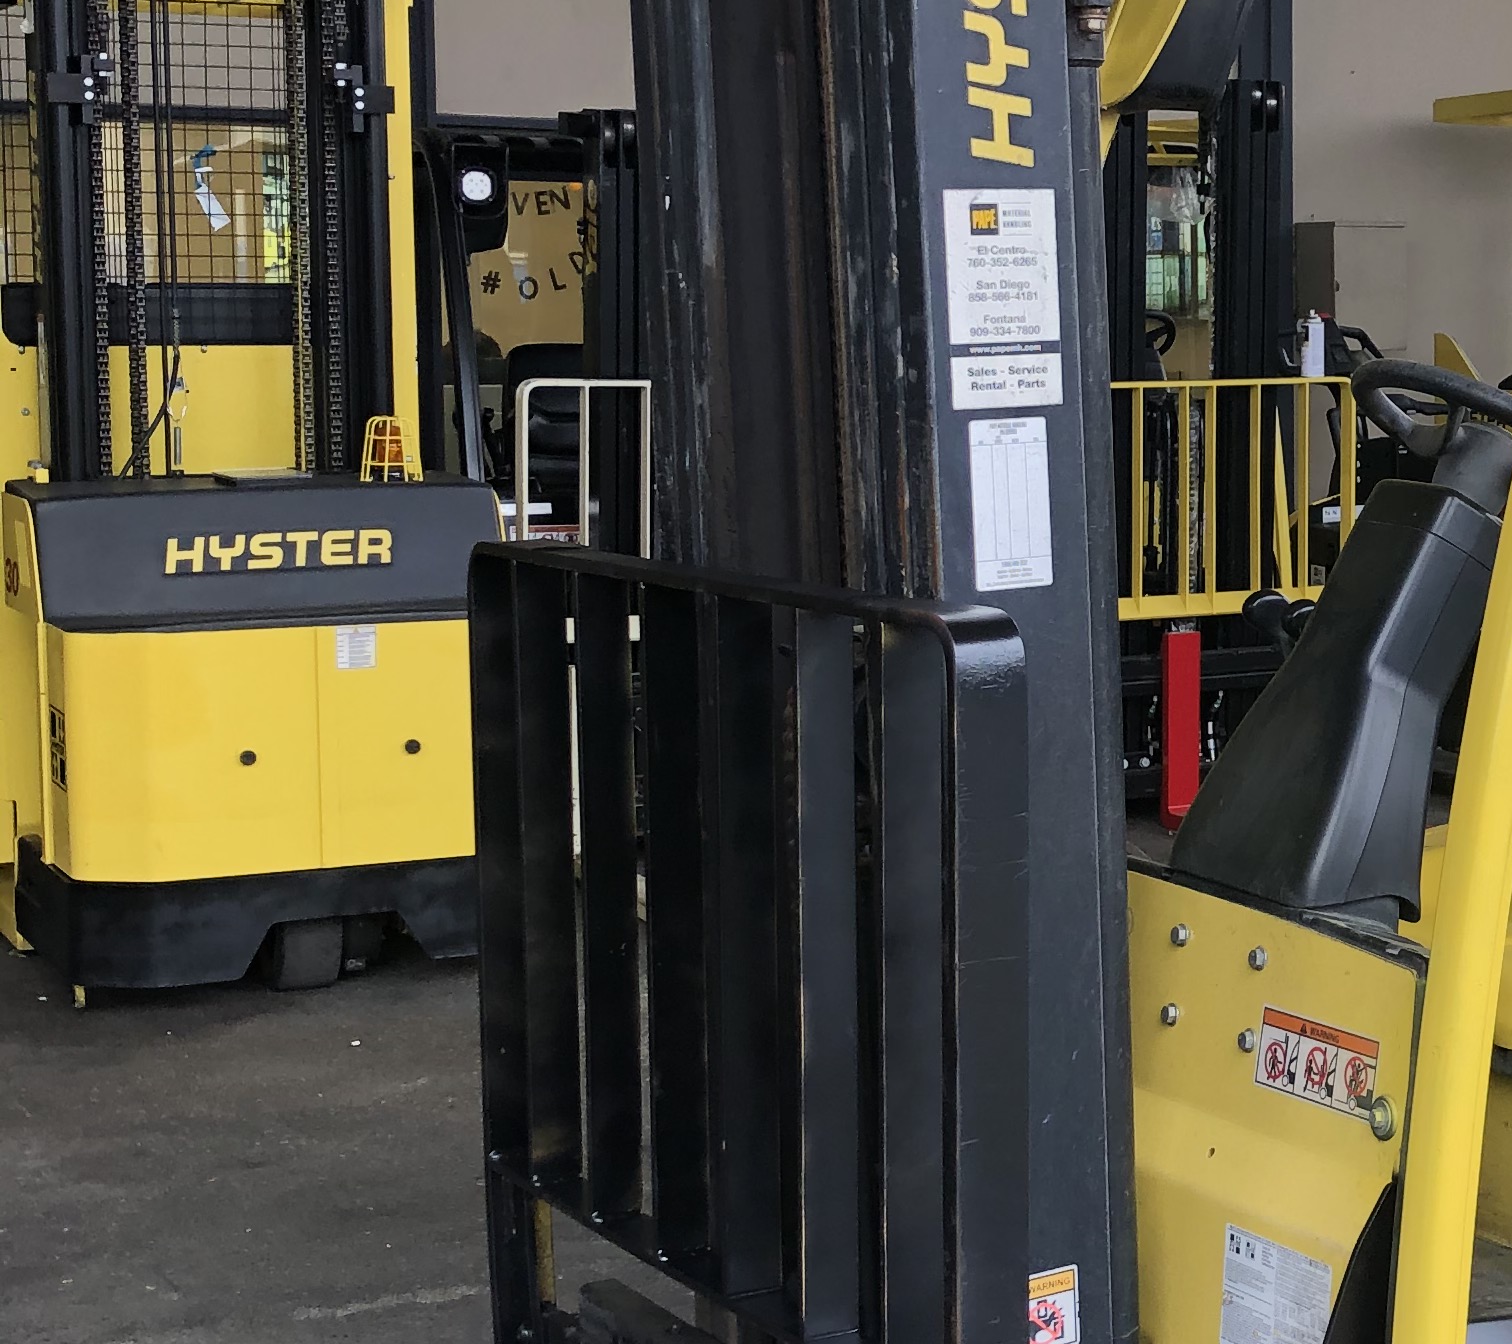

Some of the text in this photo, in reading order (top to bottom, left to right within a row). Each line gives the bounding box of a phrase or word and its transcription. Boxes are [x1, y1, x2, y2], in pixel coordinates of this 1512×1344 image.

[990, 244, 1026, 255] Centro
[976, 279, 1030, 291] San Diego
[983, 314, 1026, 324] Fontana
[967, 367, 997, 377] Sales
[1008, 365, 1048, 375] Service
[971, 380, 1007, 391] Rental
[1017, 378, 1046, 389] Parts
[165, 528, 393, 574] HYSTER
[5, 557, 20, 597] 30
[1311, 1027, 1339, 1043] WARNING
